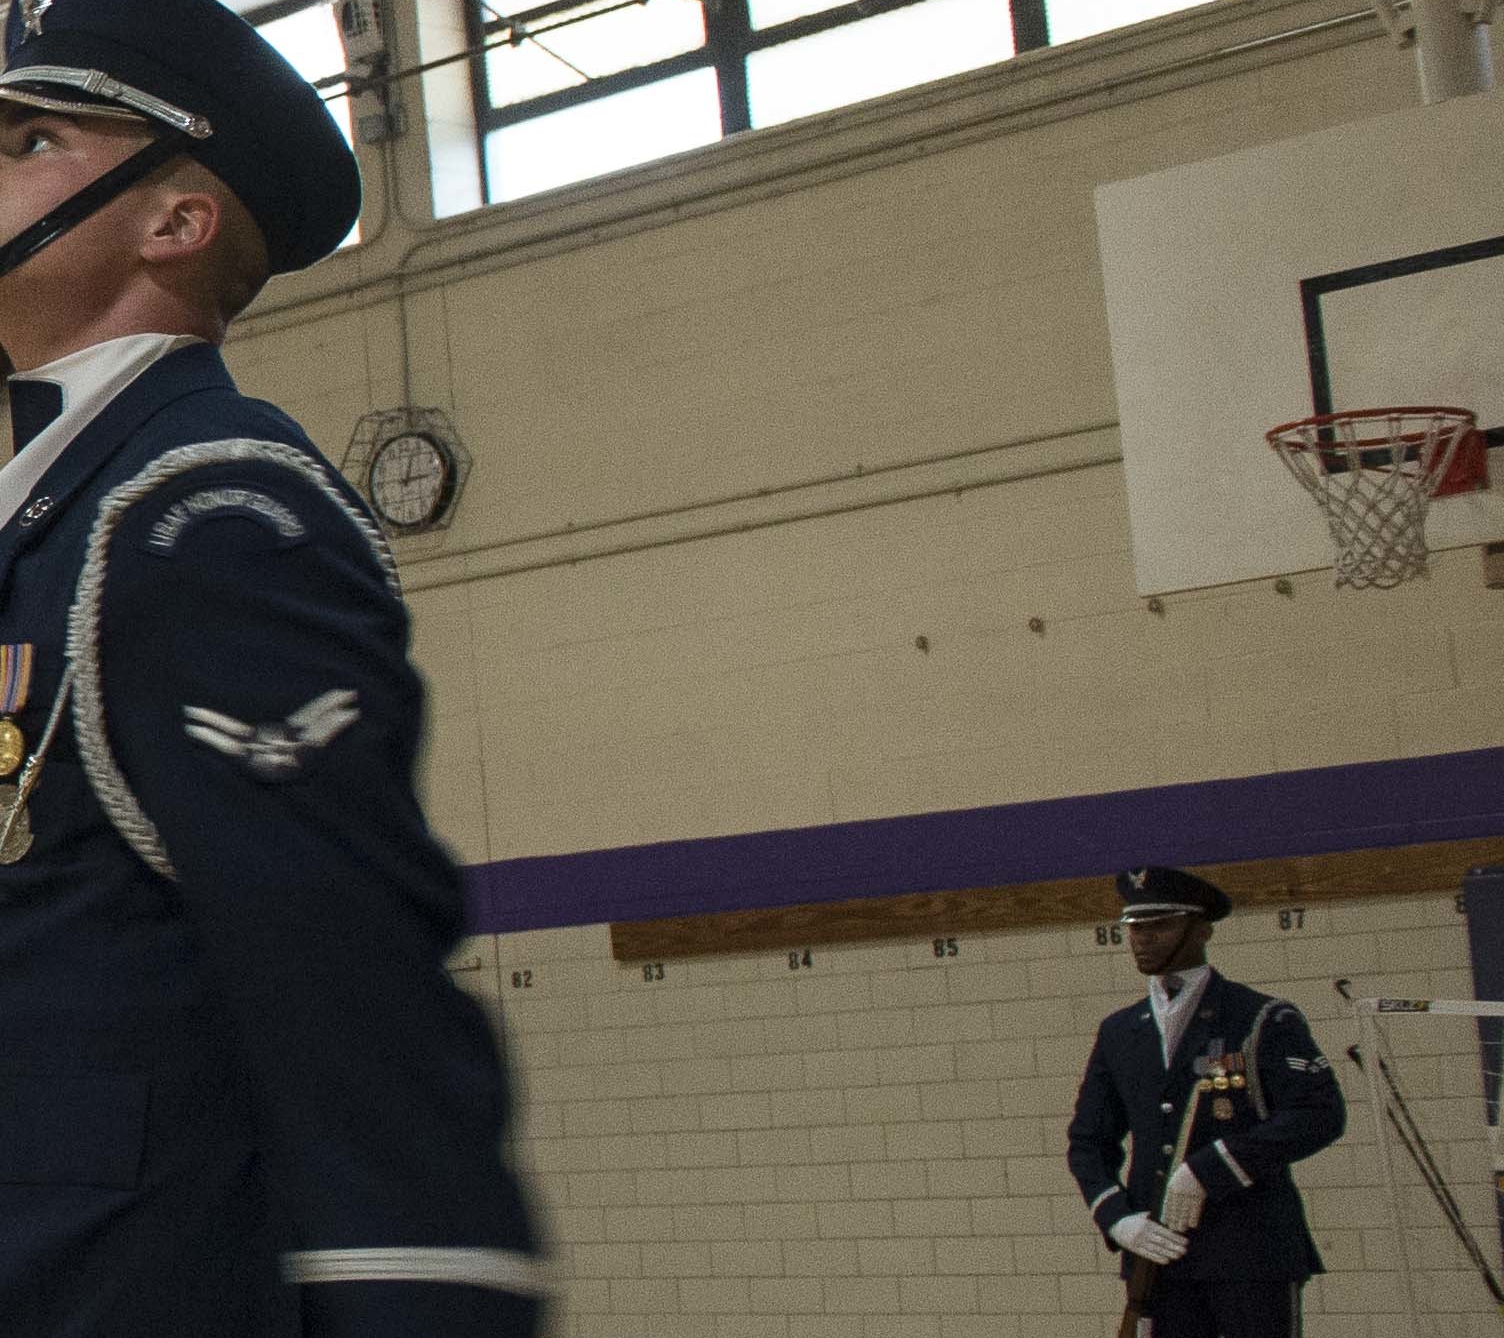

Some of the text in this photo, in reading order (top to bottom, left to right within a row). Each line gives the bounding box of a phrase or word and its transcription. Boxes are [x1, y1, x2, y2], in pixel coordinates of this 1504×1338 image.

[1279, 908, 1305, 930] 87
[1096, 926, 1122, 945] 86
[933, 938, 959, 958] 85
[788, 949, 813, 970] 84
[512, 970, 533, 989] 82
[642, 963, 665, 982] 83
